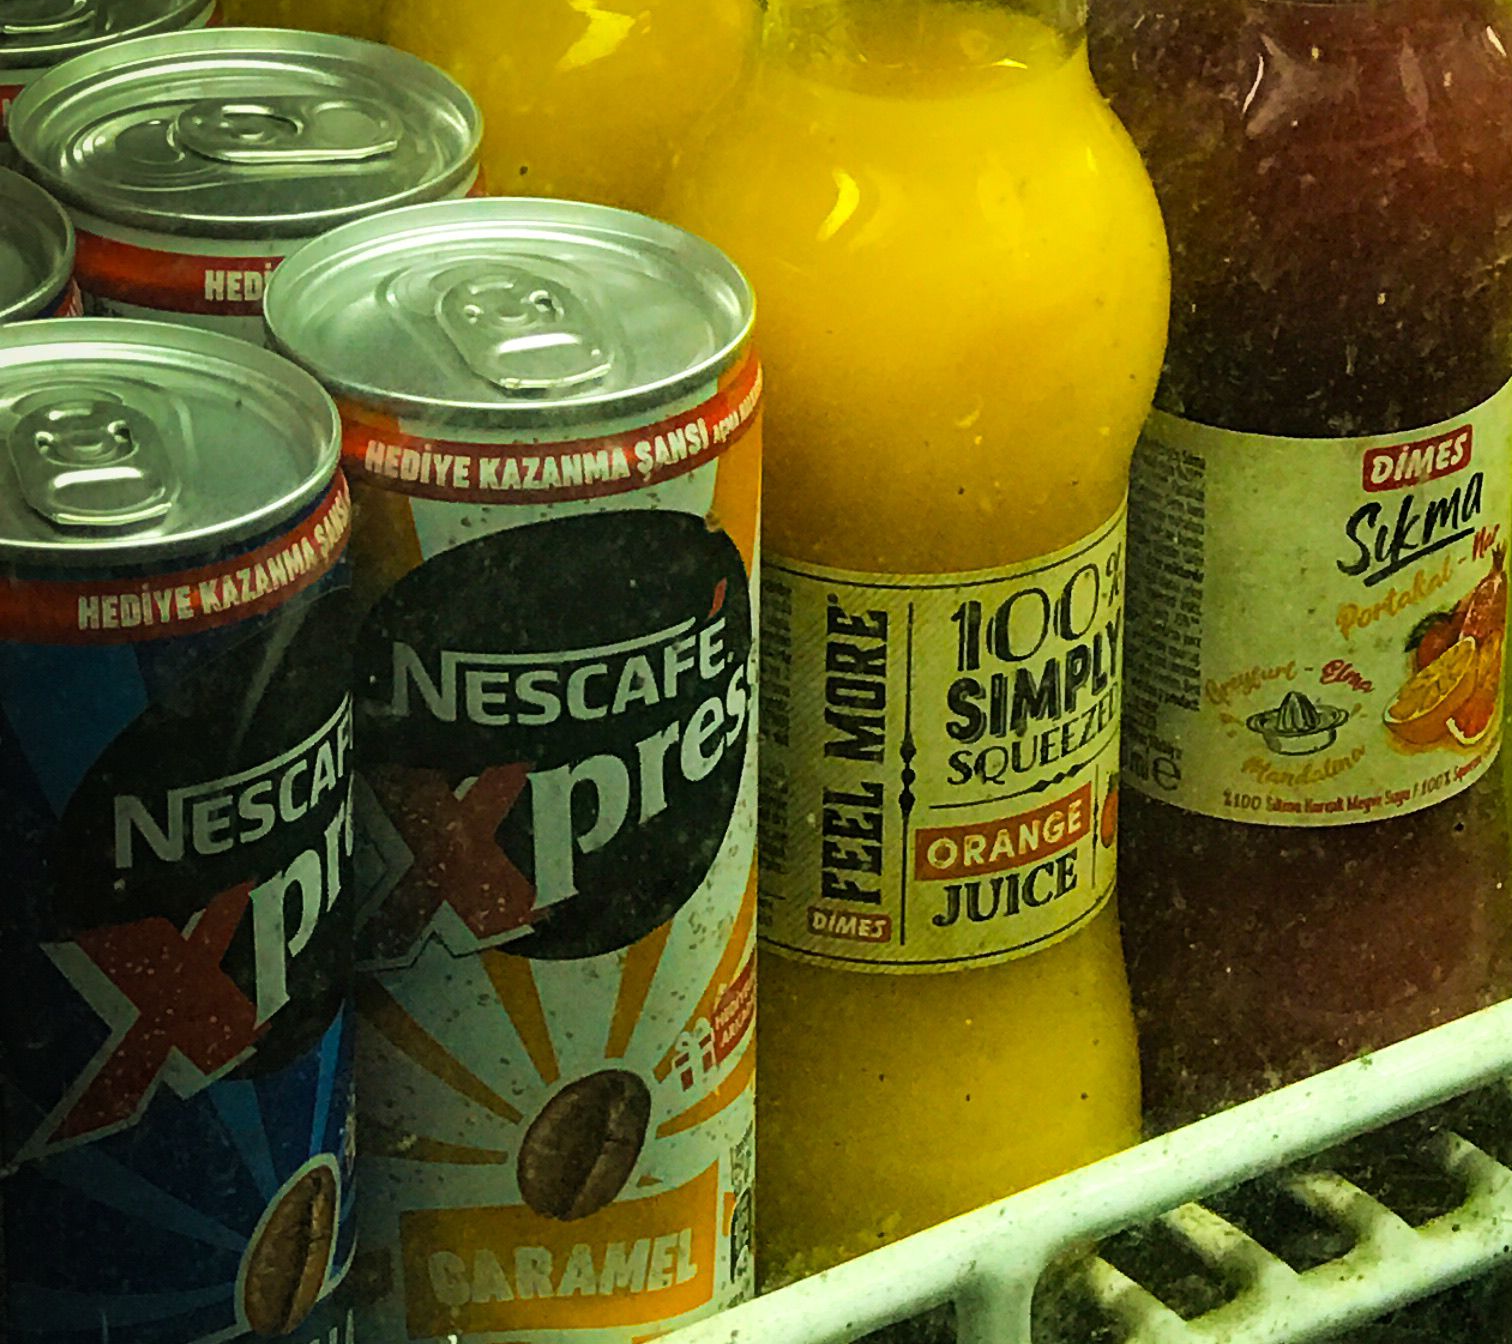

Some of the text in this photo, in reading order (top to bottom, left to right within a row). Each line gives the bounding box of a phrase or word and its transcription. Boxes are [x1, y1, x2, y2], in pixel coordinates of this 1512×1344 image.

[364, 438, 471, 490] HEDİYE
[478, 448, 631, 491] KAZANMA
[1369, 431, 1468, 485] DİMES
[78, 581, 194, 631] HEDİYE
[198, 536, 316, 616] KAZANMA
[823, 608, 889, 766] MORE
[945, 607, 1123, 745] SIMPLY
[821, 780, 886, 906] FEEL
[927, 798, 1083, 870] ORANGE
[931, 848, 1079, 928] JUICE
[427, 1226, 697, 1308] CARAMEL
